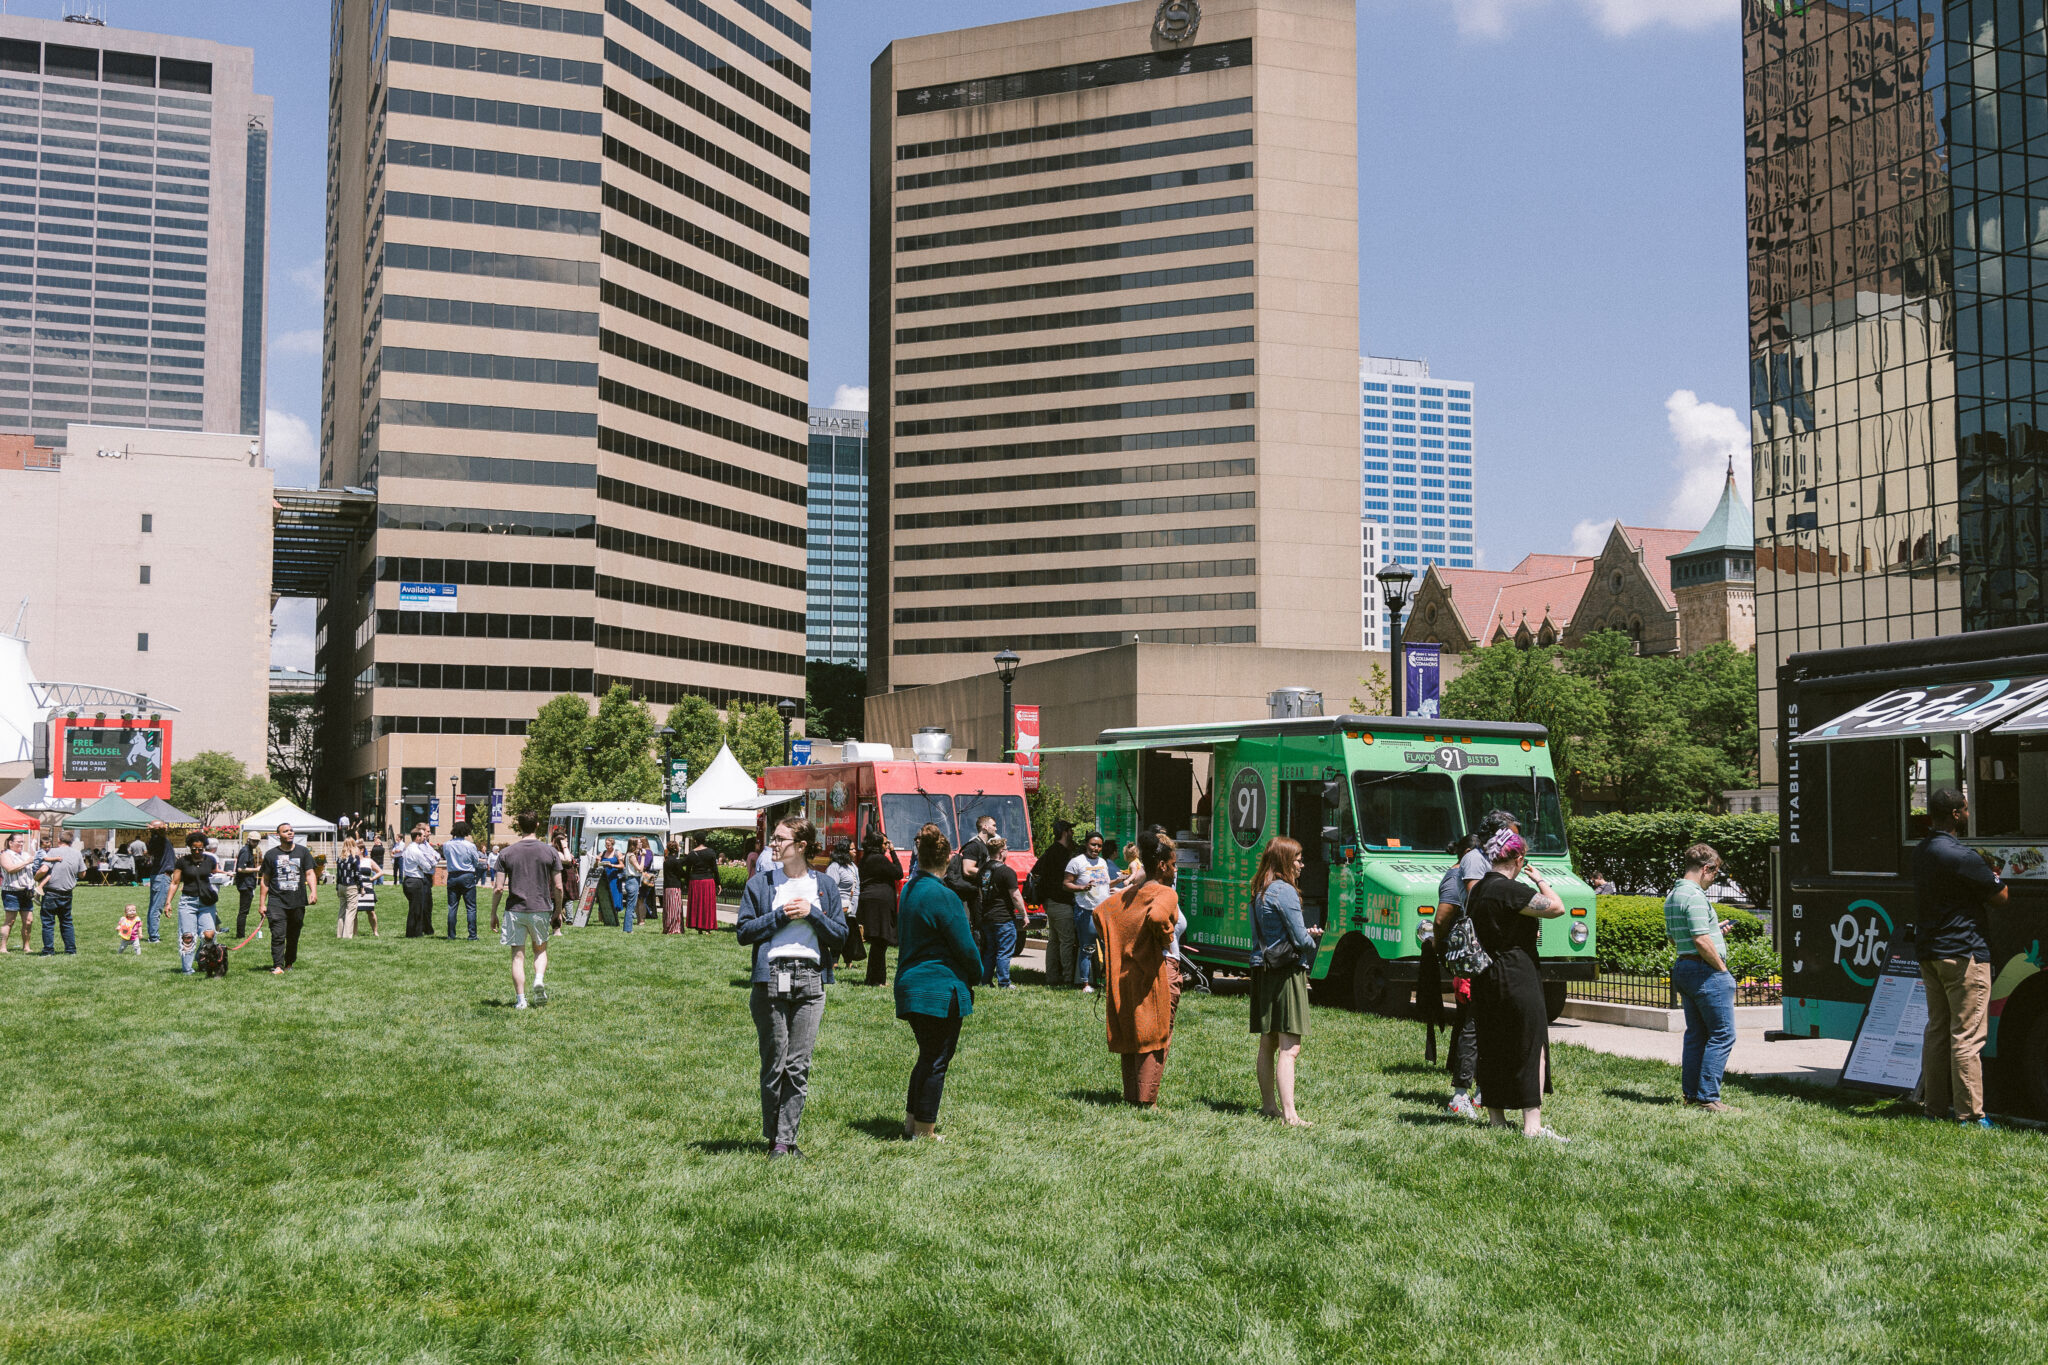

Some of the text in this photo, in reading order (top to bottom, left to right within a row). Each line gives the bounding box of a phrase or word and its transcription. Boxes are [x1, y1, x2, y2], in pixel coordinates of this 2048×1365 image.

[808, 416, 860, 429] CHASE
[401, 586, 436, 594] Available
[72, 747, 121, 756] CAROUSEL
[73, 739, 94, 747] FREE
[1405, 749, 1497, 769] FLAVOR 91 BISTRO
[1239, 774, 1258, 785] FLAVOR
[1237, 787, 1258, 829] 91
[591, 816, 668, 826] MAGIC HANDS
[1269, 808, 1277, 836] OHIO
[1236, 831, 1257, 841] BISTRO
[1389, 864, 1431, 873] BEST
[1535, 867, 1567, 876] HIO
[1190, 868, 1198, 916] SOURCED
[1367, 893, 1401, 910] FAMILY
[1239, 903, 1248, 921] NO
[1366, 908, 1401, 926] OWNED
[1364, 925, 1402, 943] NON GMO
[1830, 914, 1888, 968] Pita
